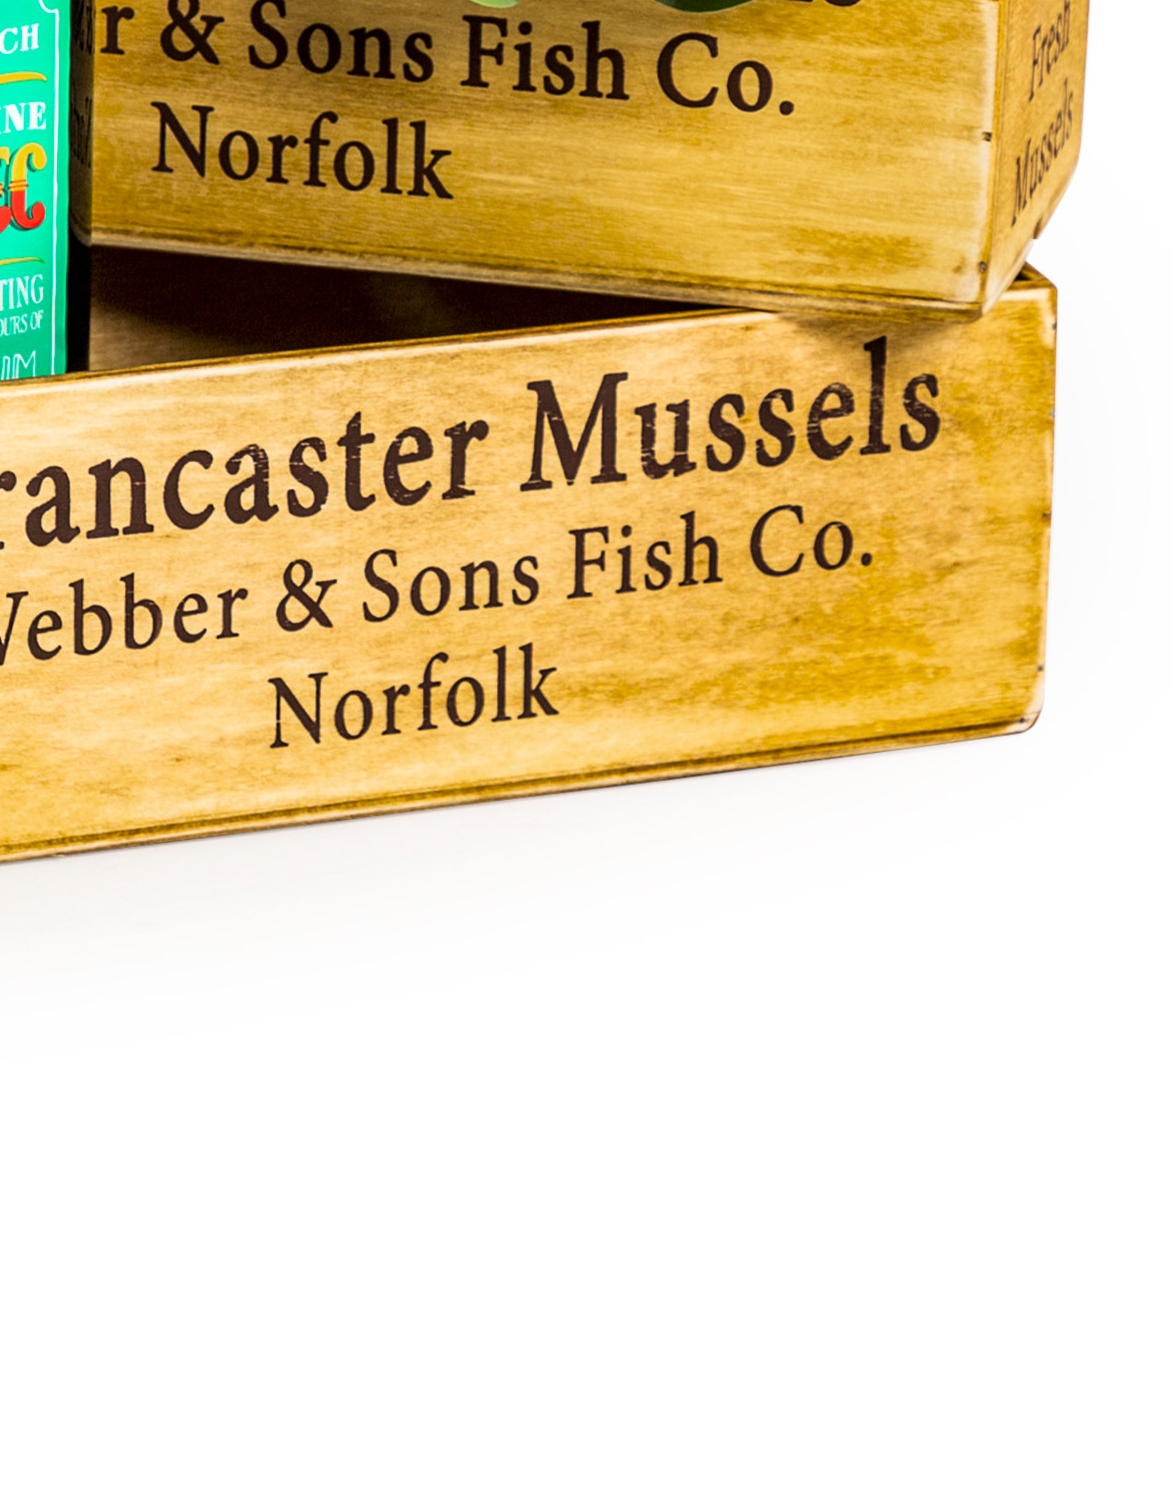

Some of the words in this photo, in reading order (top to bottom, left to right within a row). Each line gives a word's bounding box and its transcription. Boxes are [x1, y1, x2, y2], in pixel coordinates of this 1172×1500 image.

[460, 15, 629, 100] Fish
[656, 32, 795, 116] Co.
[151, 101, 454, 200] Norfolk
[1011, 76, 1074, 228] Mussels
[30, 309, 44, 331] OF
[520, 335, 941, 492] Mussels
[274, 558, 338, 633] &
[362, 548, 540, 623] Sons
[567, 510, 723, 599] Fish
[749, 504, 874, 577] Co.
[268, 642, 559, 749] Norfolk
